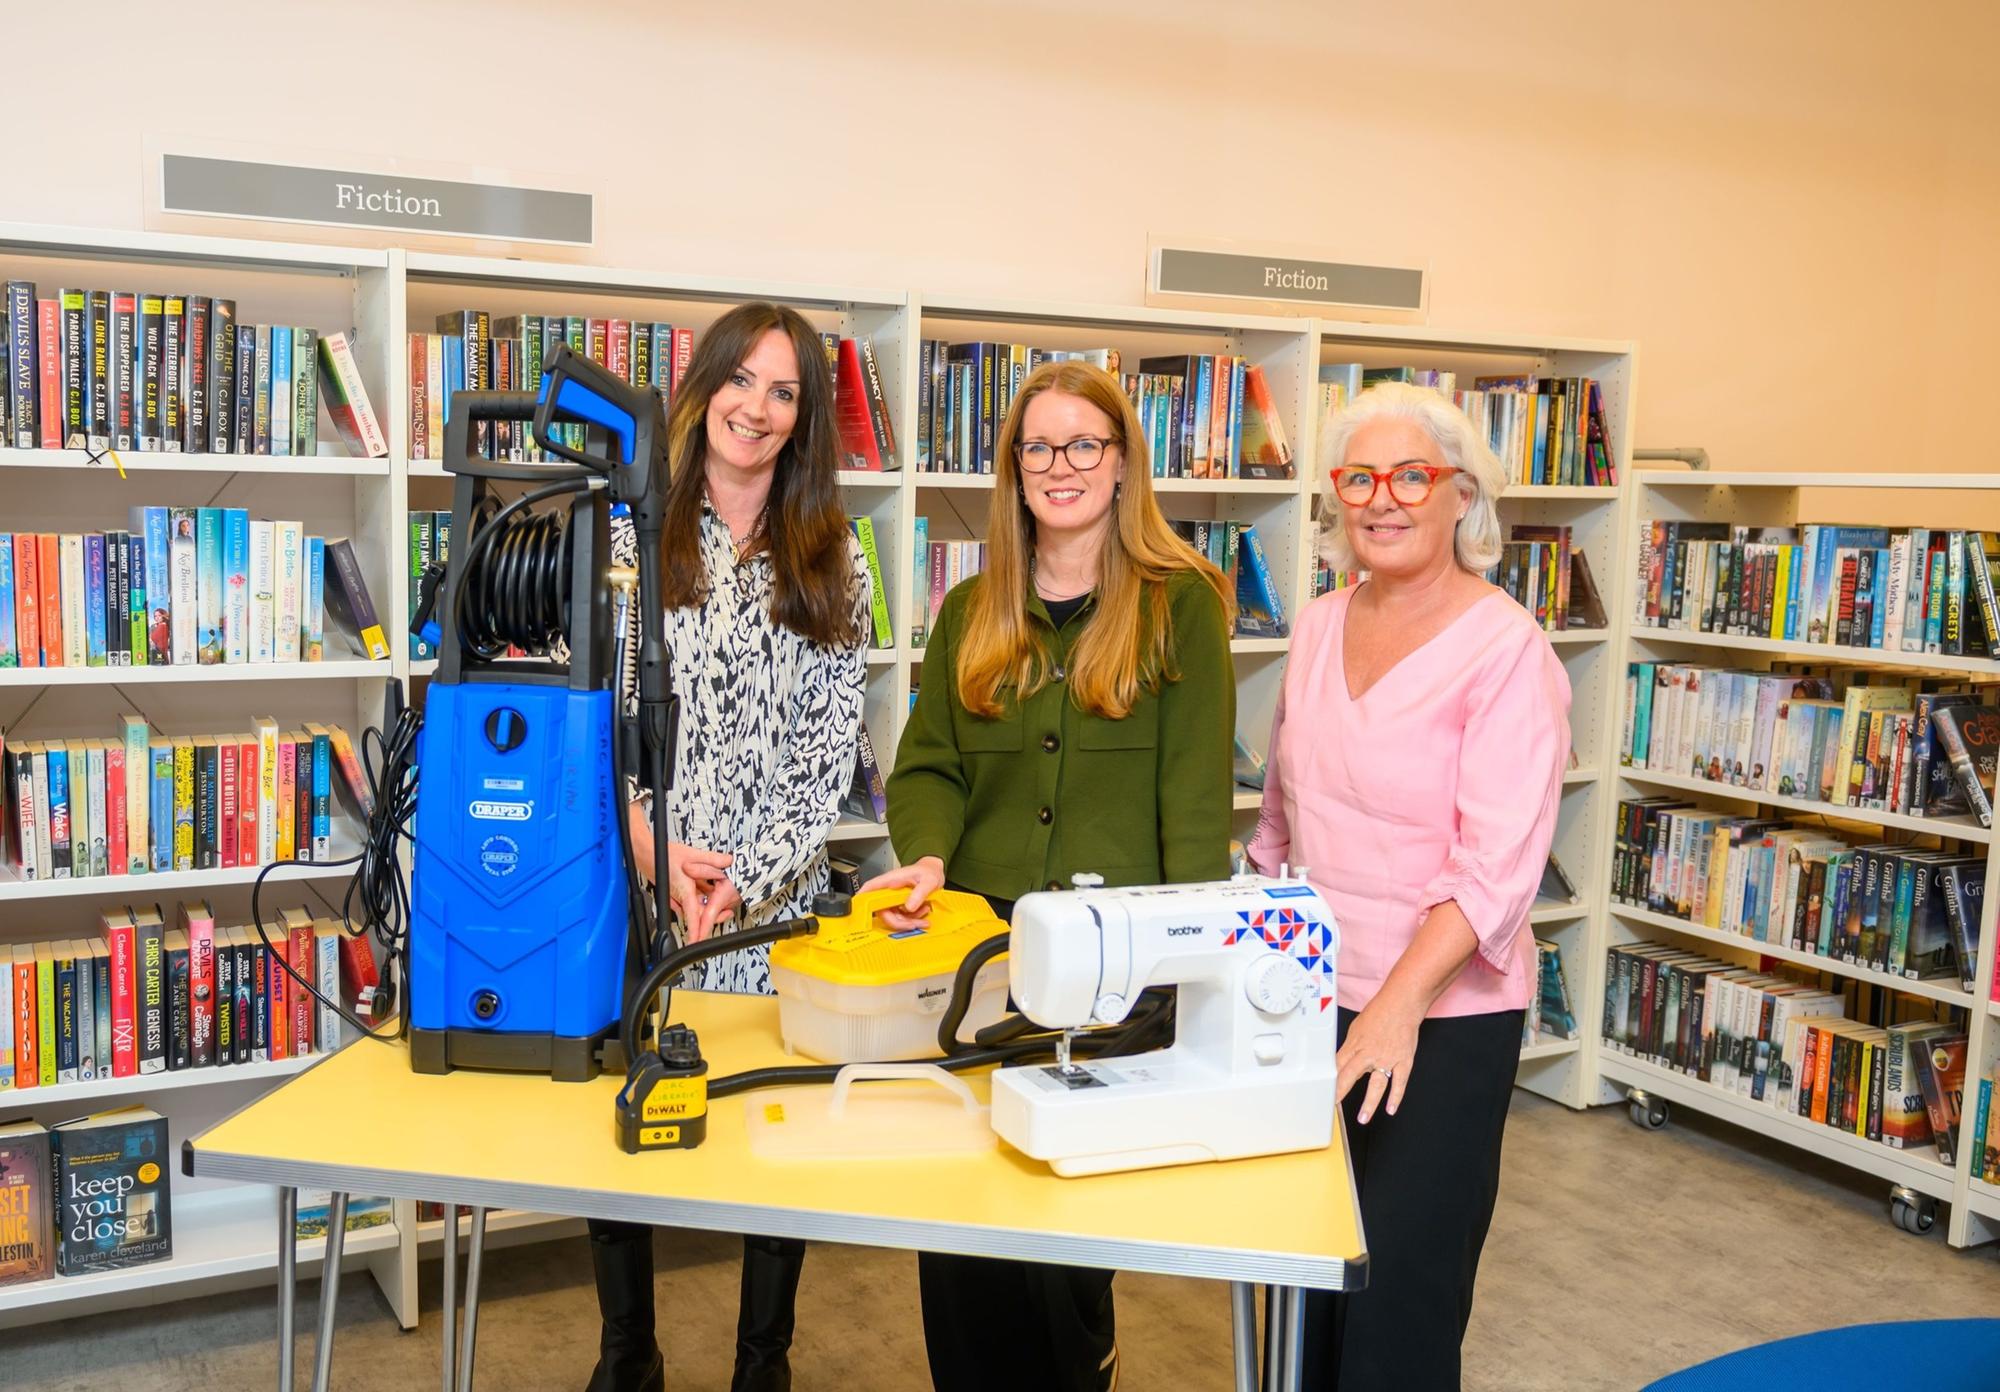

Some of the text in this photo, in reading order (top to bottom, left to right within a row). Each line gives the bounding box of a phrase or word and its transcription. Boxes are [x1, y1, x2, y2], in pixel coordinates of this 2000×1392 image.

[335, 184, 442, 217] Fiction
[1264, 267, 1328, 291] Fiction
[17, 294, 32, 390] DEVIL'S SLAVE
[70, 313, 80, 389] PARADISE VALLEY
[95, 320, 106, 378] LONG RANGE
[120, 316, 131, 392] THE DISAPPEARED
[147, 327, 158, 378] WOLF PACK
[168, 321, 178, 392] THE BITTERROOTS
[193, 316, 204, 386] SHADOWS REEL
[215, 333, 225, 362] GRID
[224, 324, 234, 374] OFF THE
[594, 336, 603, 359] LEE
[678, 334, 689, 367] MATCH
[923, 345, 931, 375] Bernard
[47, 359, 55, 374] ME
[242, 350, 250, 397] STONE COLD
[257, 348, 270, 385] guest
[863, 340, 882, 401] TOM CLANCY
[18, 395, 27, 430] BORMAN
[70, 391, 80, 426] C.J. BOX
[96, 383, 106, 422] C.J. BOX
[120, 393, 130, 432] C.J. BOX
[147, 383, 157, 419] C.J. BOX
[168, 394, 177, 428] C.J. BOX
[193, 391, 203, 427] C.J. BOX
[218, 389, 228, 433] C.J. BOX
[297, 382, 306, 440] JOHN BOYNE
[240, 406, 250, 440] C.J. BOX
[120, 543, 128, 574] DUPLICITY
[284, 530, 296, 578] Fern Britton
[860, 522, 884, 606] Ann Cleeves
[1638, 525, 1651, 579] LISA GARDNER
[1838, 560, 1857, 619] BETRAYAL
[1859, 556, 1869, 589] GIMENEZ
[1888, 545, 1905, 615] All My Mothers
[1930, 563, 1942, 618] PANIC ROOM
[110, 583, 118, 610] BRASSETT
[121, 578, 129, 623] PETE BRASSETT
[1853, 609, 1863, 636] LAWYER
[1947, 592, 1959, 640] SECRETS
[1916, 699, 1929, 737] Alex Gray
[304, 752, 312, 774] HELEN
[861, 731, 876, 765] MICHAEL
[21, 796, 34, 828] WIFE
[53, 802, 67, 839] Wake
[200, 770, 208, 834] JESSIE BURTON
[207, 758, 216, 845] THE MINIATURIST
[474, 804, 526, 817] DRAPER
[1657, 815, 1668, 855] MARK GREANEY
[1673, 818, 1684, 856] MARK GREANEY
[1689, 822, 1700, 863] MARK GREANEY
[1699, 839, 1710, 876] MARK GREANEY
[1851, 855, 1863, 892] Griffiths
[1865, 859, 1878, 896] Griffiths
[1881, 862, 1894, 900] Griffiths
[1913, 868, 1927, 906] Griffiths
[1943, 876, 1959, 915] Griffiths
[1167, 926, 1204, 937] brother
[117, 933, 128, 997] Claudia Carroll
[145, 937, 160, 1005] CHRIS CARTER
[192, 938, 201, 980] ADVOCATE
[200, 938, 211, 980] DEVIL'S
[242, 959, 250, 979] STEVE
[1606, 953, 1616, 986] Griffiths
[1617, 959, 1628, 993] Griffiths
[1631, 961, 1640, 994] Griffiths
[1642, 964, 1652, 997] Griffiths
[1654, 977, 1664, 1010] Griffiths
[1680, 976, 1690, 1009] Griffiths
[63, 981, 72, 1038] THE VACANCY
[173, 1010, 181, 1038] CASEY
[178, 972, 188, 1049] THE KILLING KIND
[192, 1005, 204, 1048] Cavanagh
[202, 1014, 212, 1038] Steve
[220, 1002, 230, 1046] TWISTED
[256, 997, 265, 1046] Steve Cavanagh
[1692, 996, 1700, 1025] Griffiths
[1733, 990, 1744, 1032] John Grisham
[113, 1018, 135, 1053] FIXER
[147, 1009, 161, 1051] GENESIS
[1803, 1032, 1816, 1084] John Grisham
[1816, 1035, 1830, 1092] John Grisham
[1887, 1033, 1905, 1093] SCRUBLANDS
[69, 1173, 135, 1200] keep
[70, 1196, 123, 1227] you
[71, 1217, 140, 1243] close
[70, 1251, 107, 1266] karen
[111, 1240, 169, 1258] cleveland
